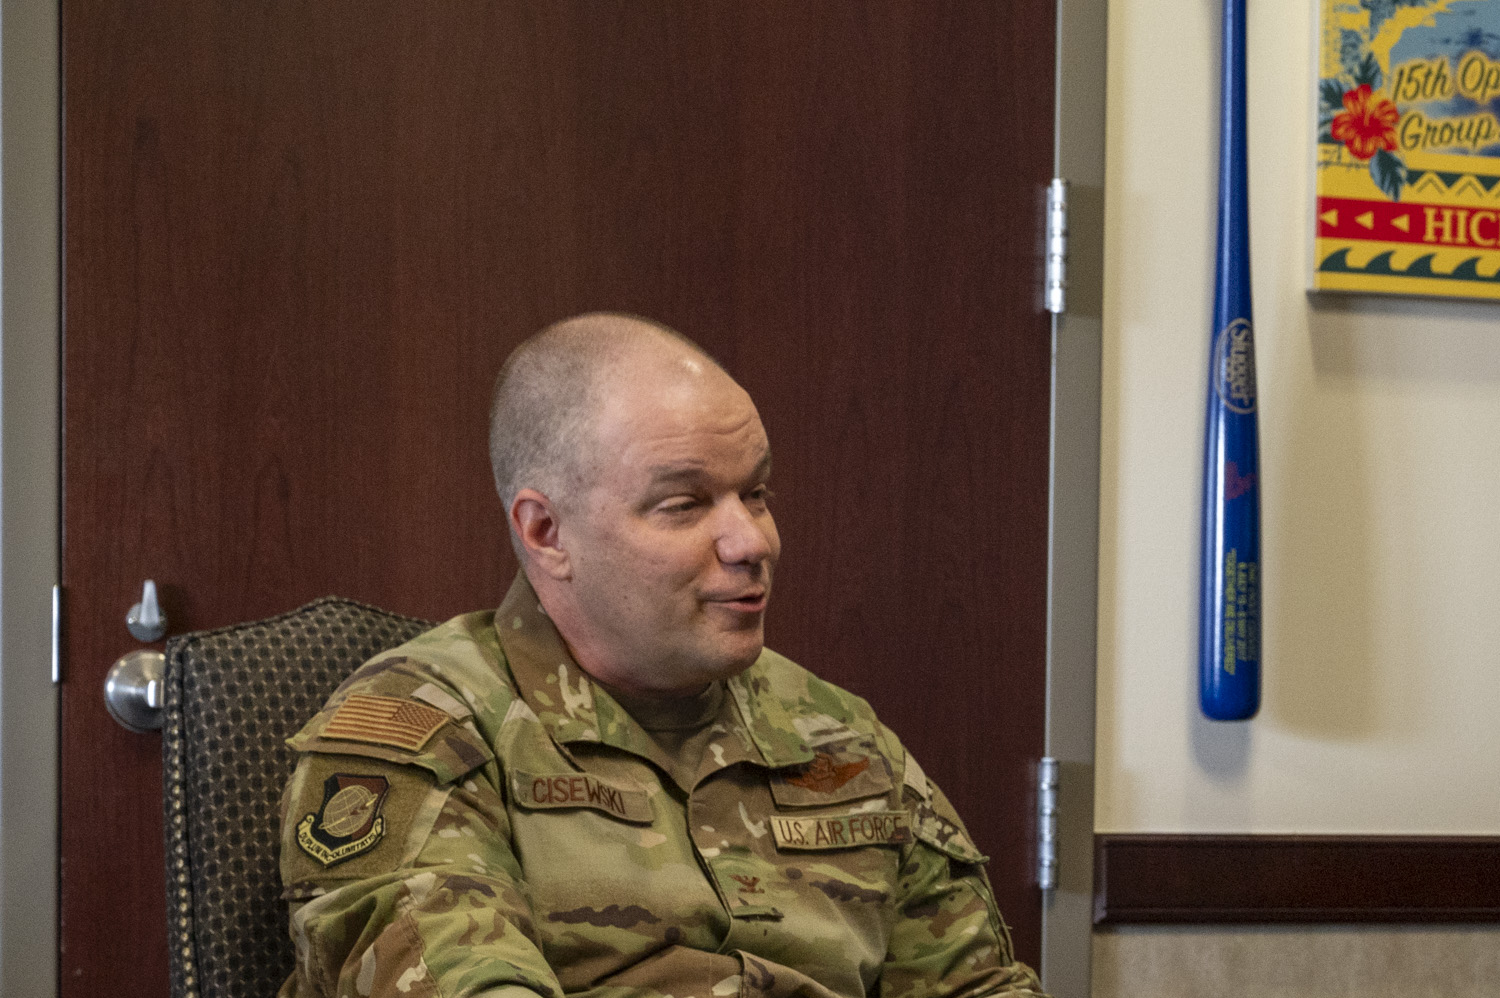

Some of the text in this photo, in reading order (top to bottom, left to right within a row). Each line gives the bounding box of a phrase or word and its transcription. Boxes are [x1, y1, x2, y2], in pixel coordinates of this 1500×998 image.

[1393, 59, 1450, 101] 15th
[533, 777, 626, 815] CISEWSKI
[778, 820, 809, 845] U.S.
[815, 820, 848, 845] AIR
